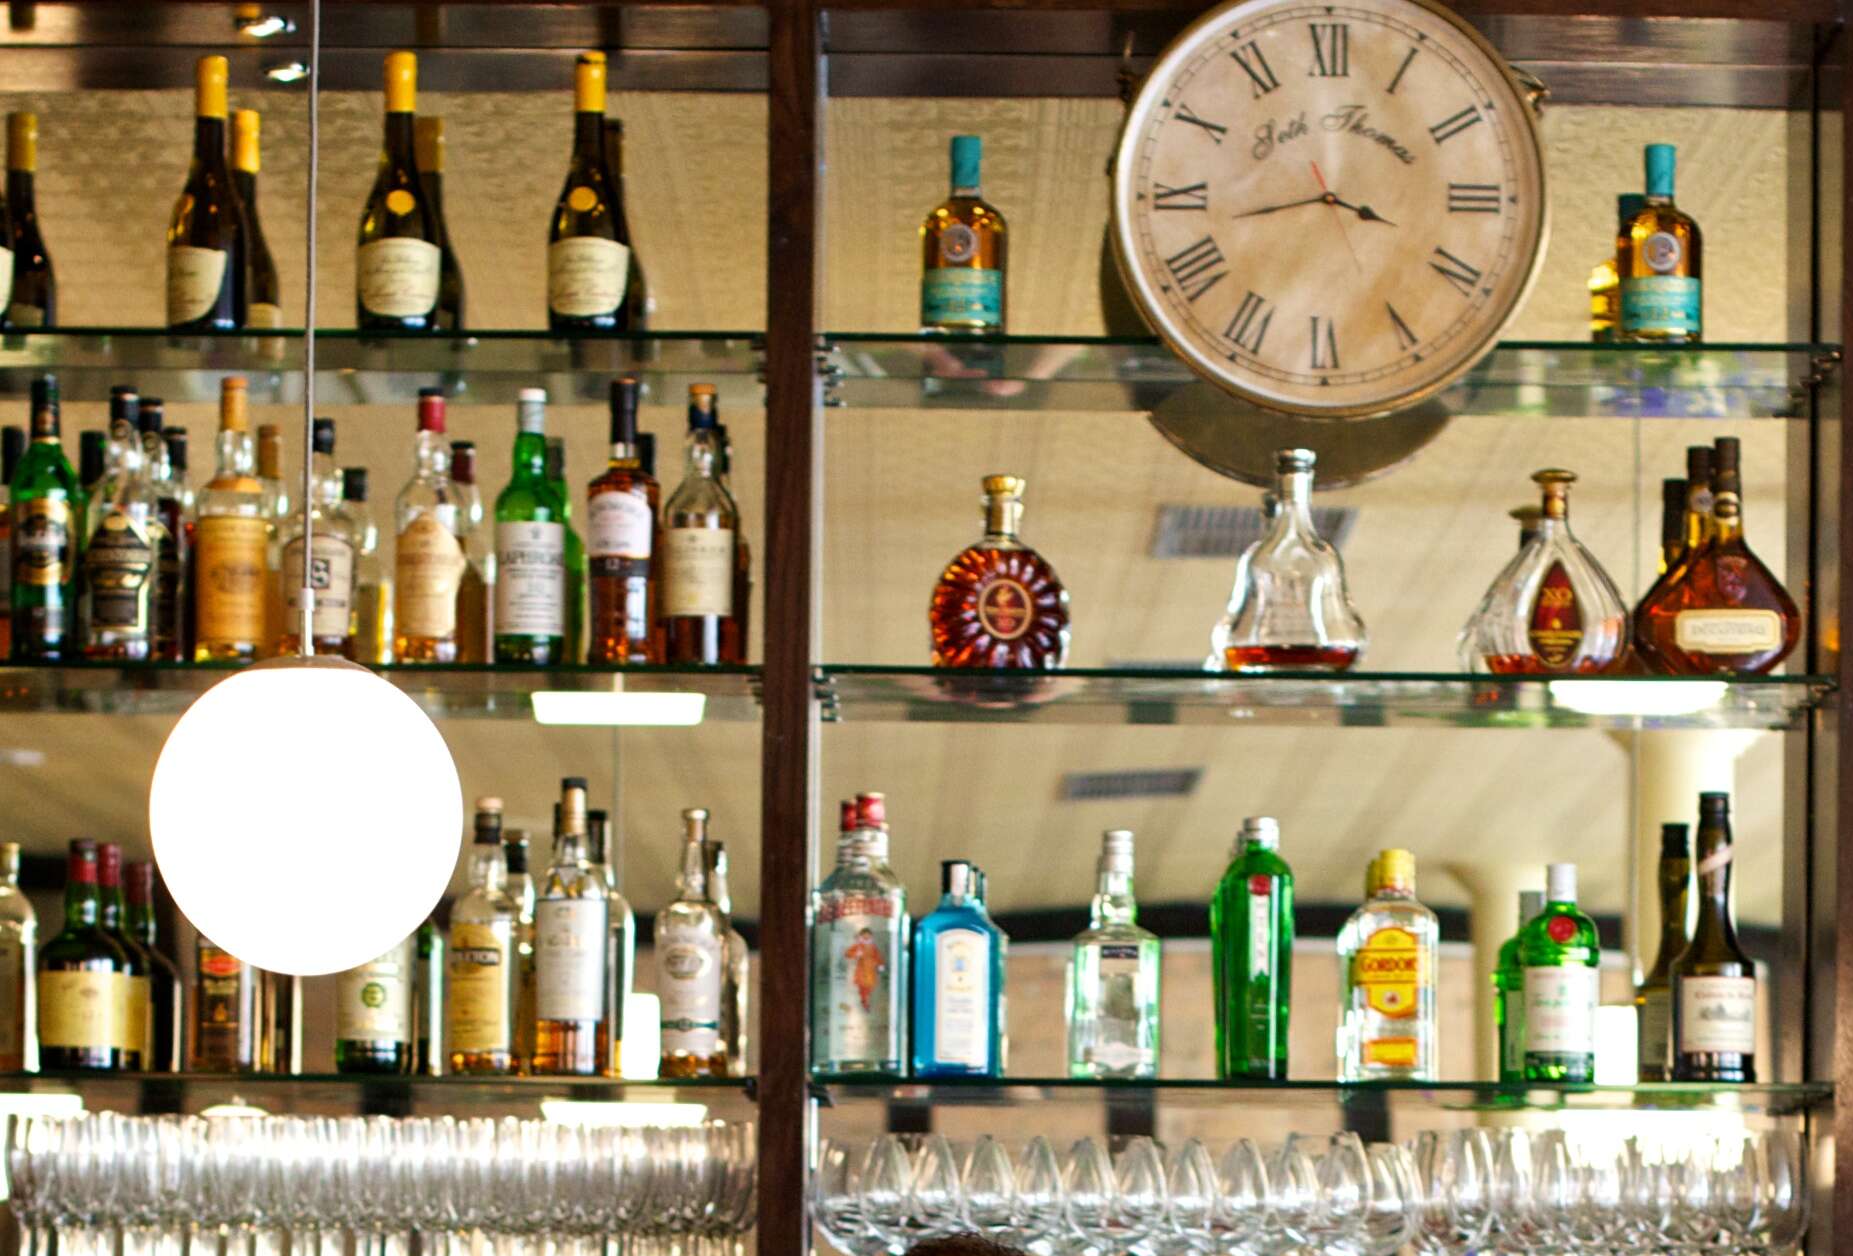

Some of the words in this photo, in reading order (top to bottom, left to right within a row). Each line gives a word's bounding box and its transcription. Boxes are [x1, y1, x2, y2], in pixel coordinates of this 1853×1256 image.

[1230, 40, 1281, 98] XI
[1308, 24, 1349, 77] XII
[1386, 47, 1419, 94] I
[1174, 103, 1227, 144] X
[1252, 111, 1309, 160] Seth
[1320, 105, 1416, 164] Thomas
[1429, 105, 1484, 145] II
[1153, 182, 1208, 210] IX
[1448, 183, 1501, 213] III
[1166, 235, 1231, 301] VIII
[1428, 246, 1482, 297] IV
[1223, 291, 1275, 355] VII
[1310, 316, 1339, 369] VI
[1386, 301, 1419, 350] V
[1360, 957, 1418, 973] GORDON
